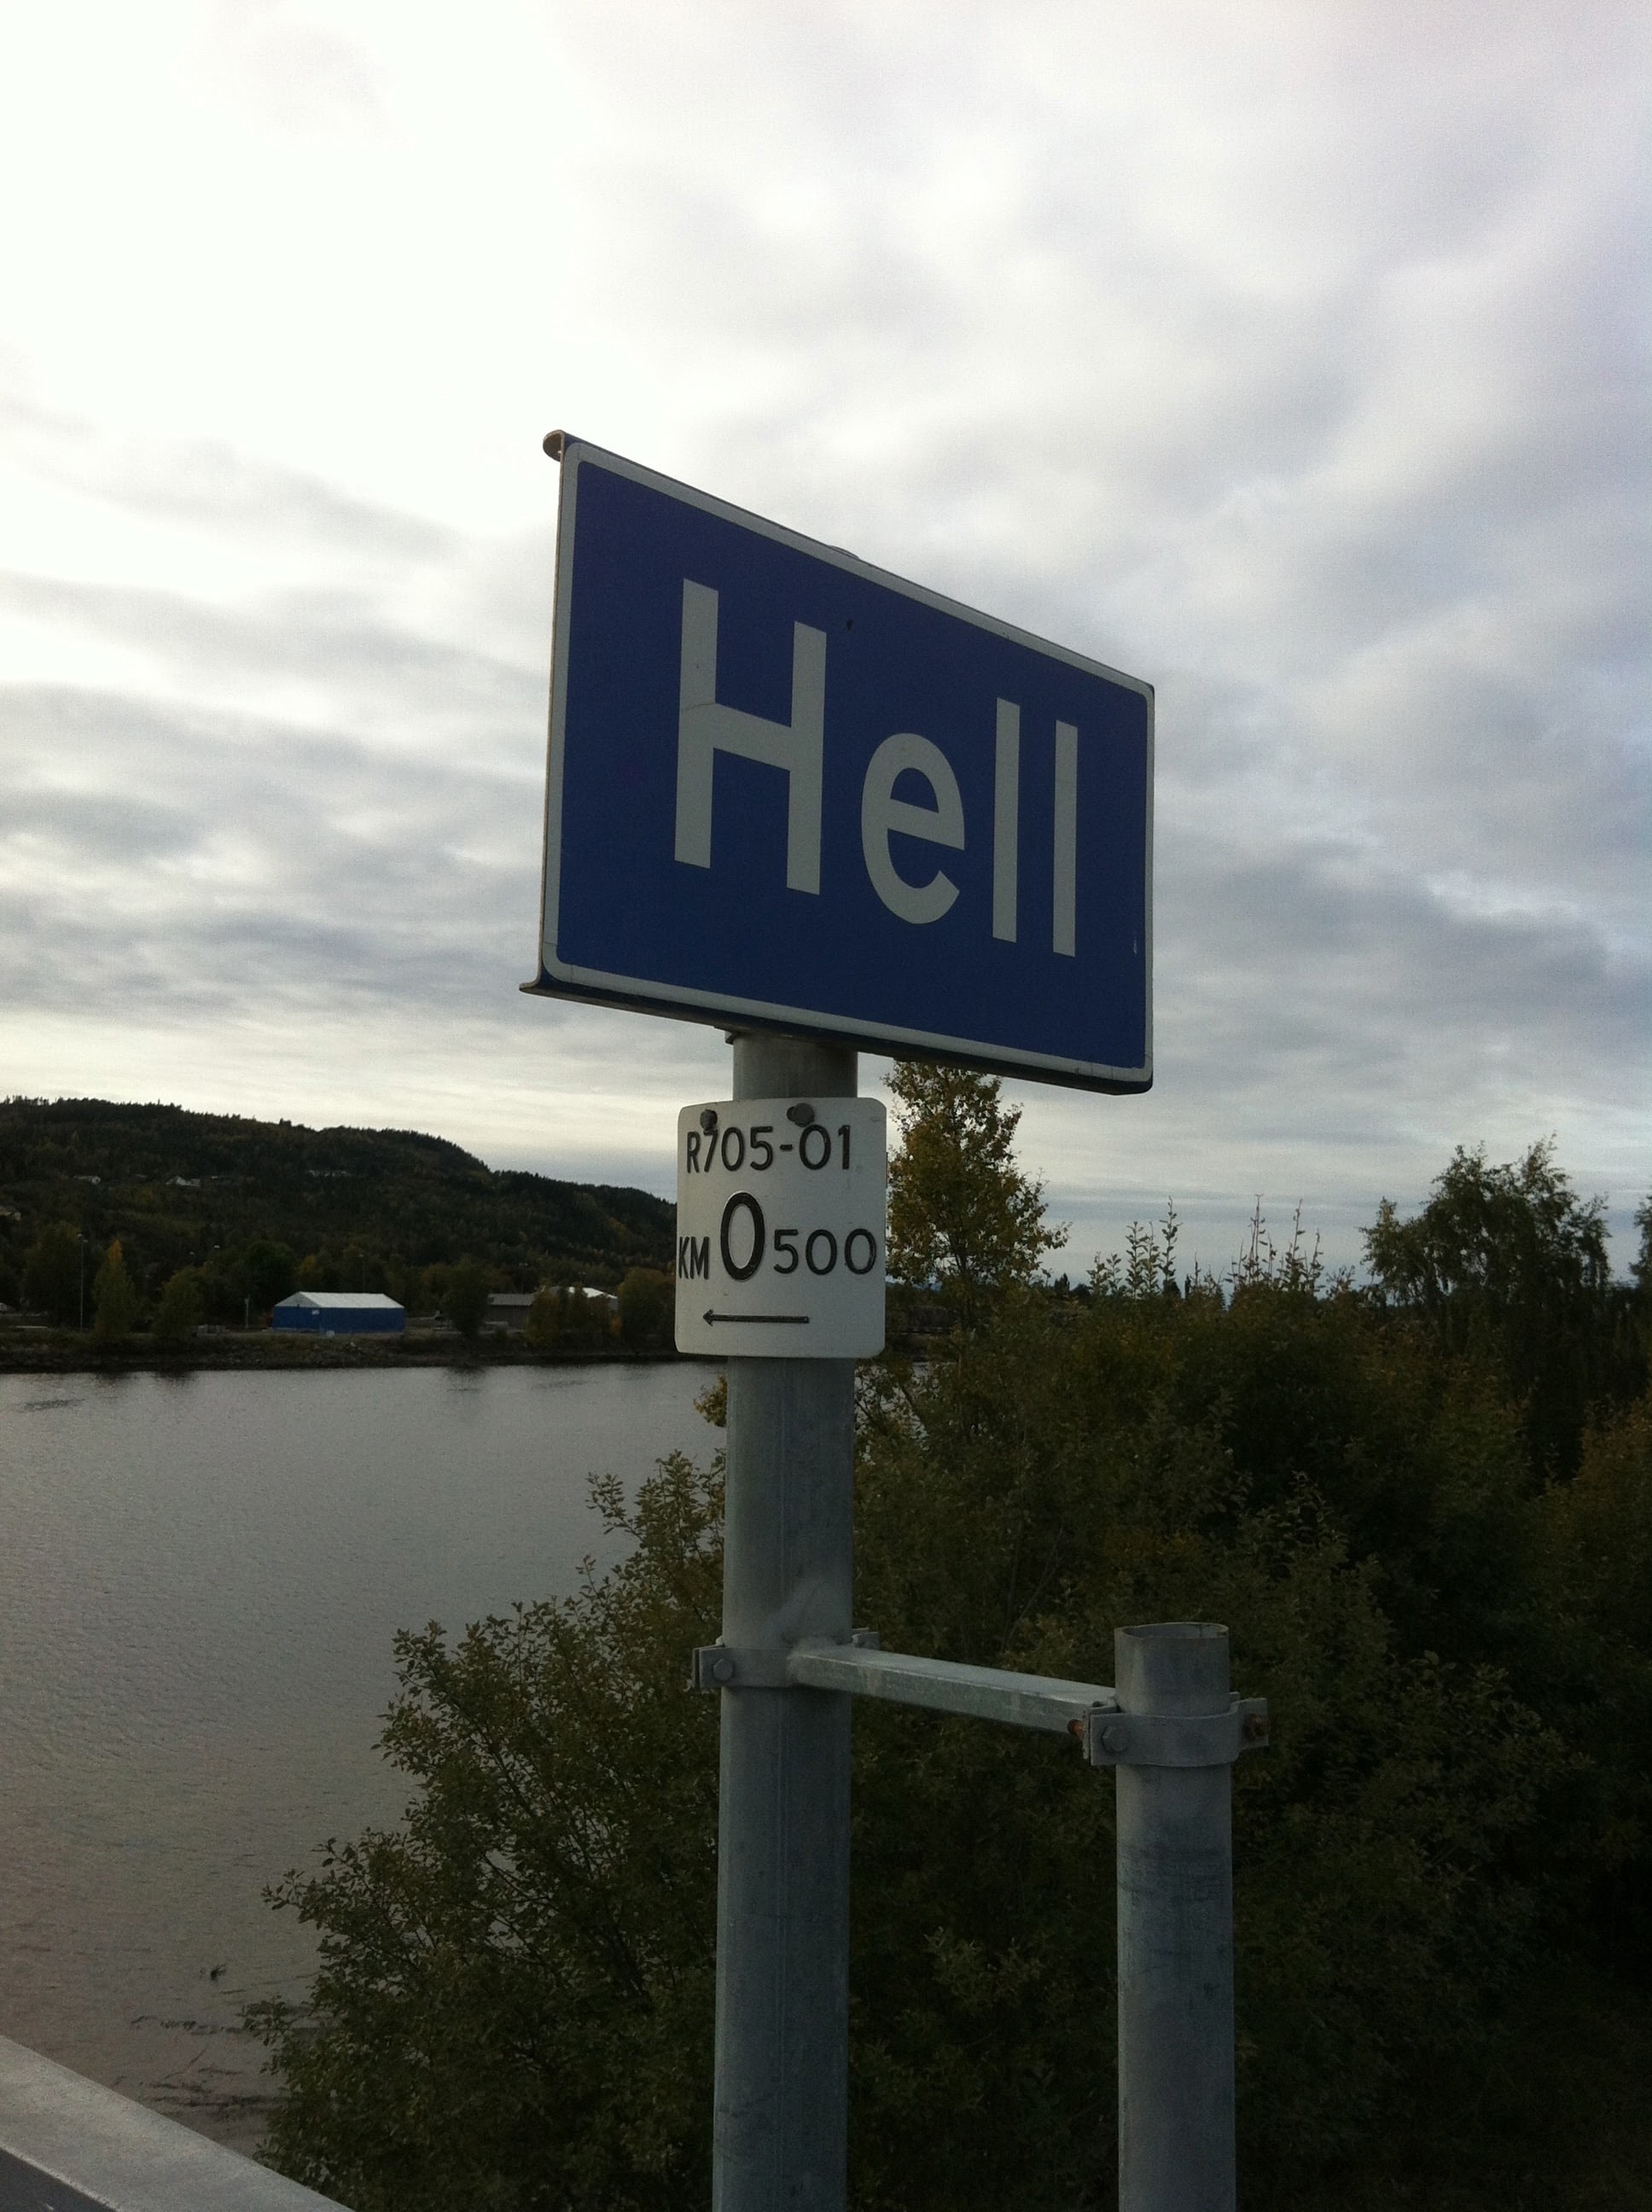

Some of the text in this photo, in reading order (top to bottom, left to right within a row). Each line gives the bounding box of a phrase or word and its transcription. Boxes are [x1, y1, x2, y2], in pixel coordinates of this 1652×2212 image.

[674, 578, 1078, 958] Hell
[686, 1124, 851, 1173] R705-01
[678, 1236, 709, 1279] KM
